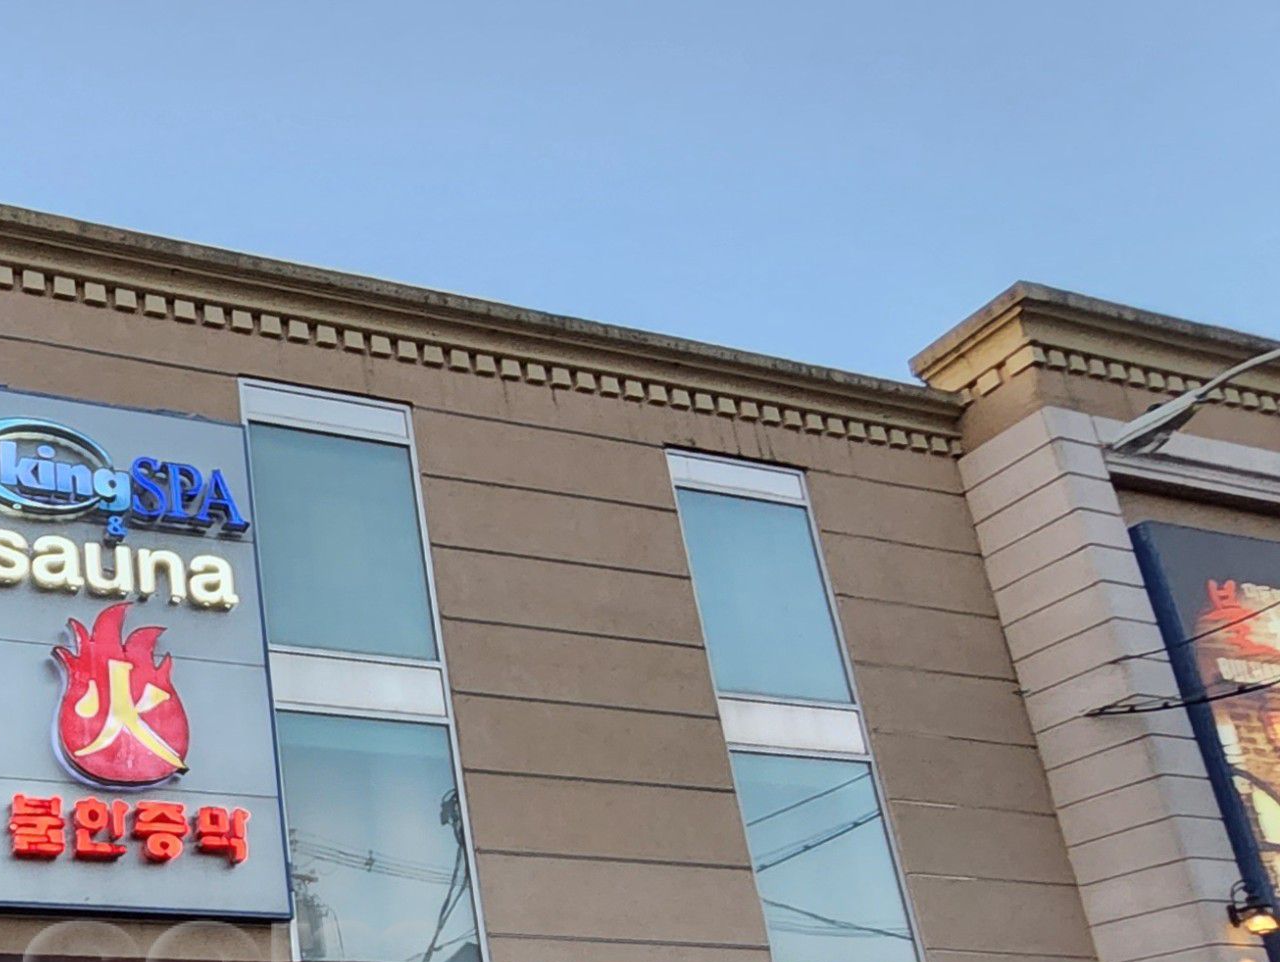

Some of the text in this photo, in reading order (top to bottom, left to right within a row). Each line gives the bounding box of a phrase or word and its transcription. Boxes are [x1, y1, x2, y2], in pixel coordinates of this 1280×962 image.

[107, 516, 128, 537] &
[131, 456, 250, 529] SPA
[74, 660, 187, 769] 火
[10, 794, 250, 864] 불한증막
